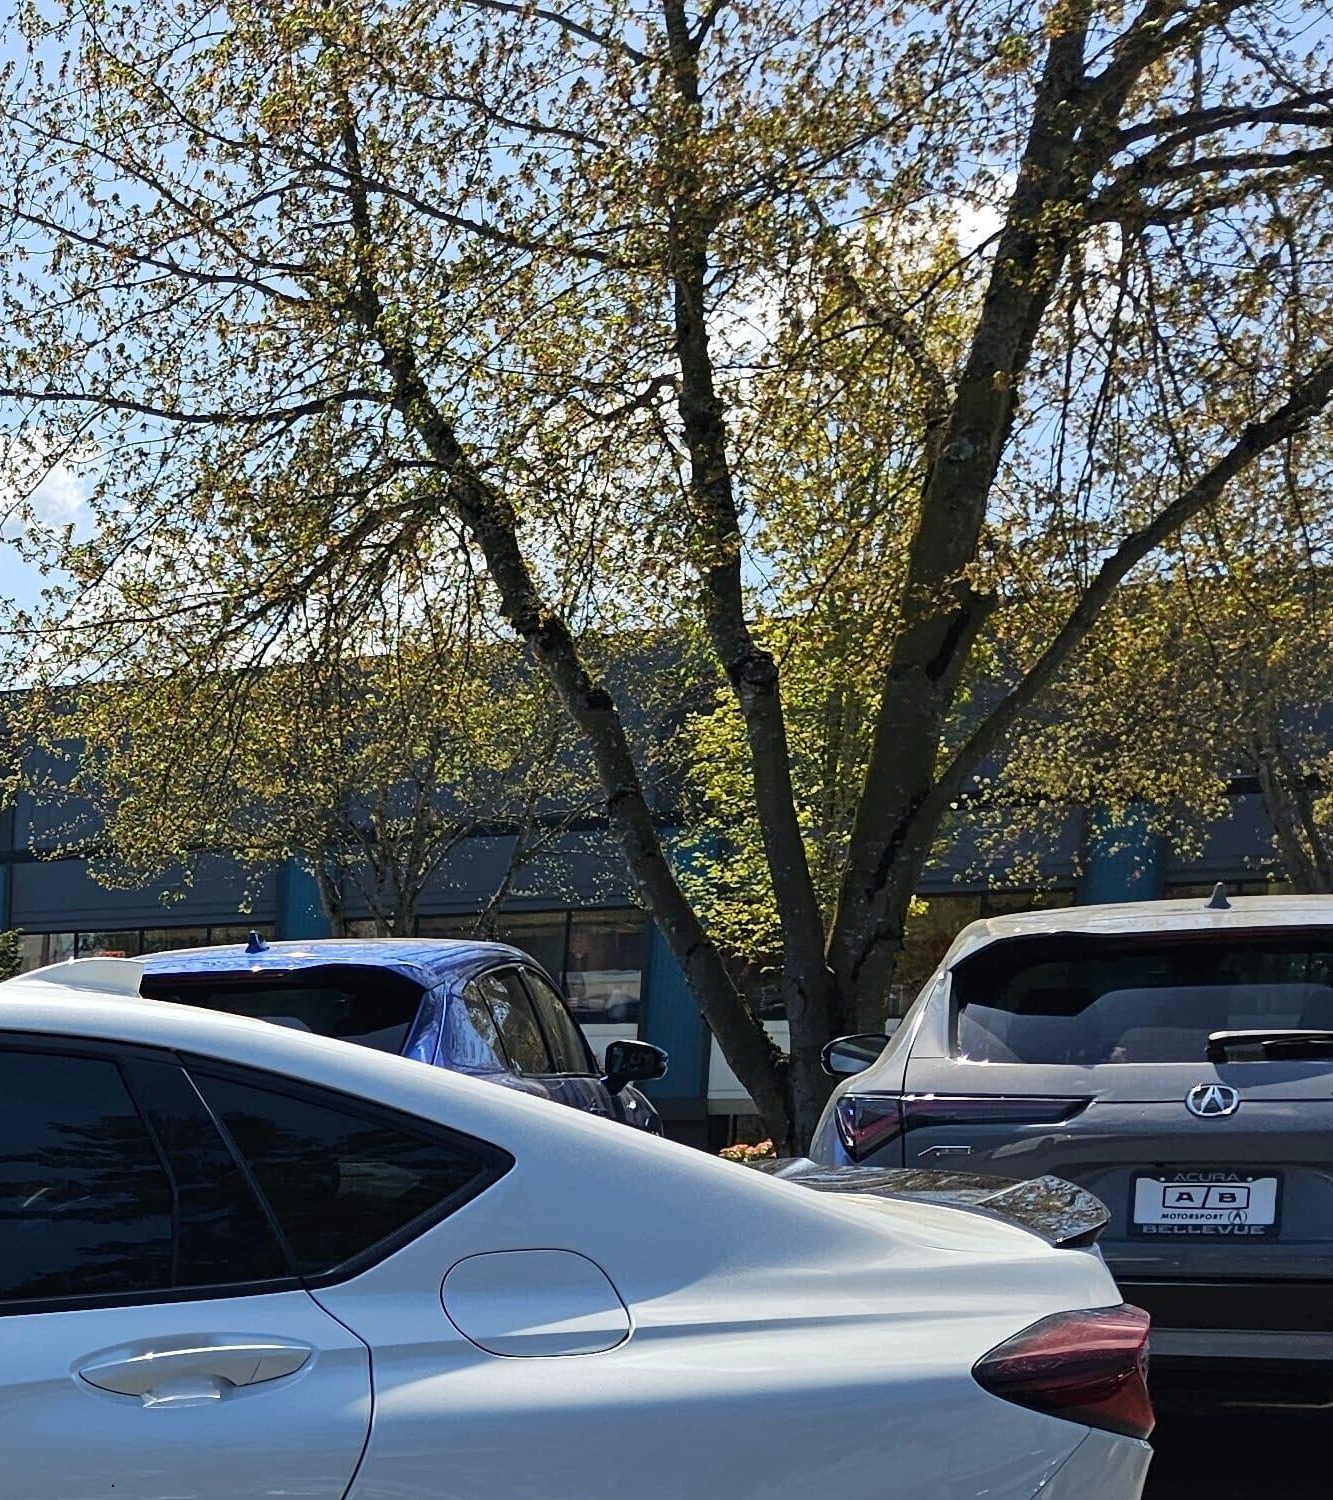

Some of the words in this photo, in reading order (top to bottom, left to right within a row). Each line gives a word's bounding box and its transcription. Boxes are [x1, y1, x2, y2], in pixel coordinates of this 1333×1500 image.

[1173, 1172, 1240, 1182] ACURA
[1160, 1213, 1224, 1221] MOTORSPORT
[1142, 1225, 1266, 1235] BELLEVUE
